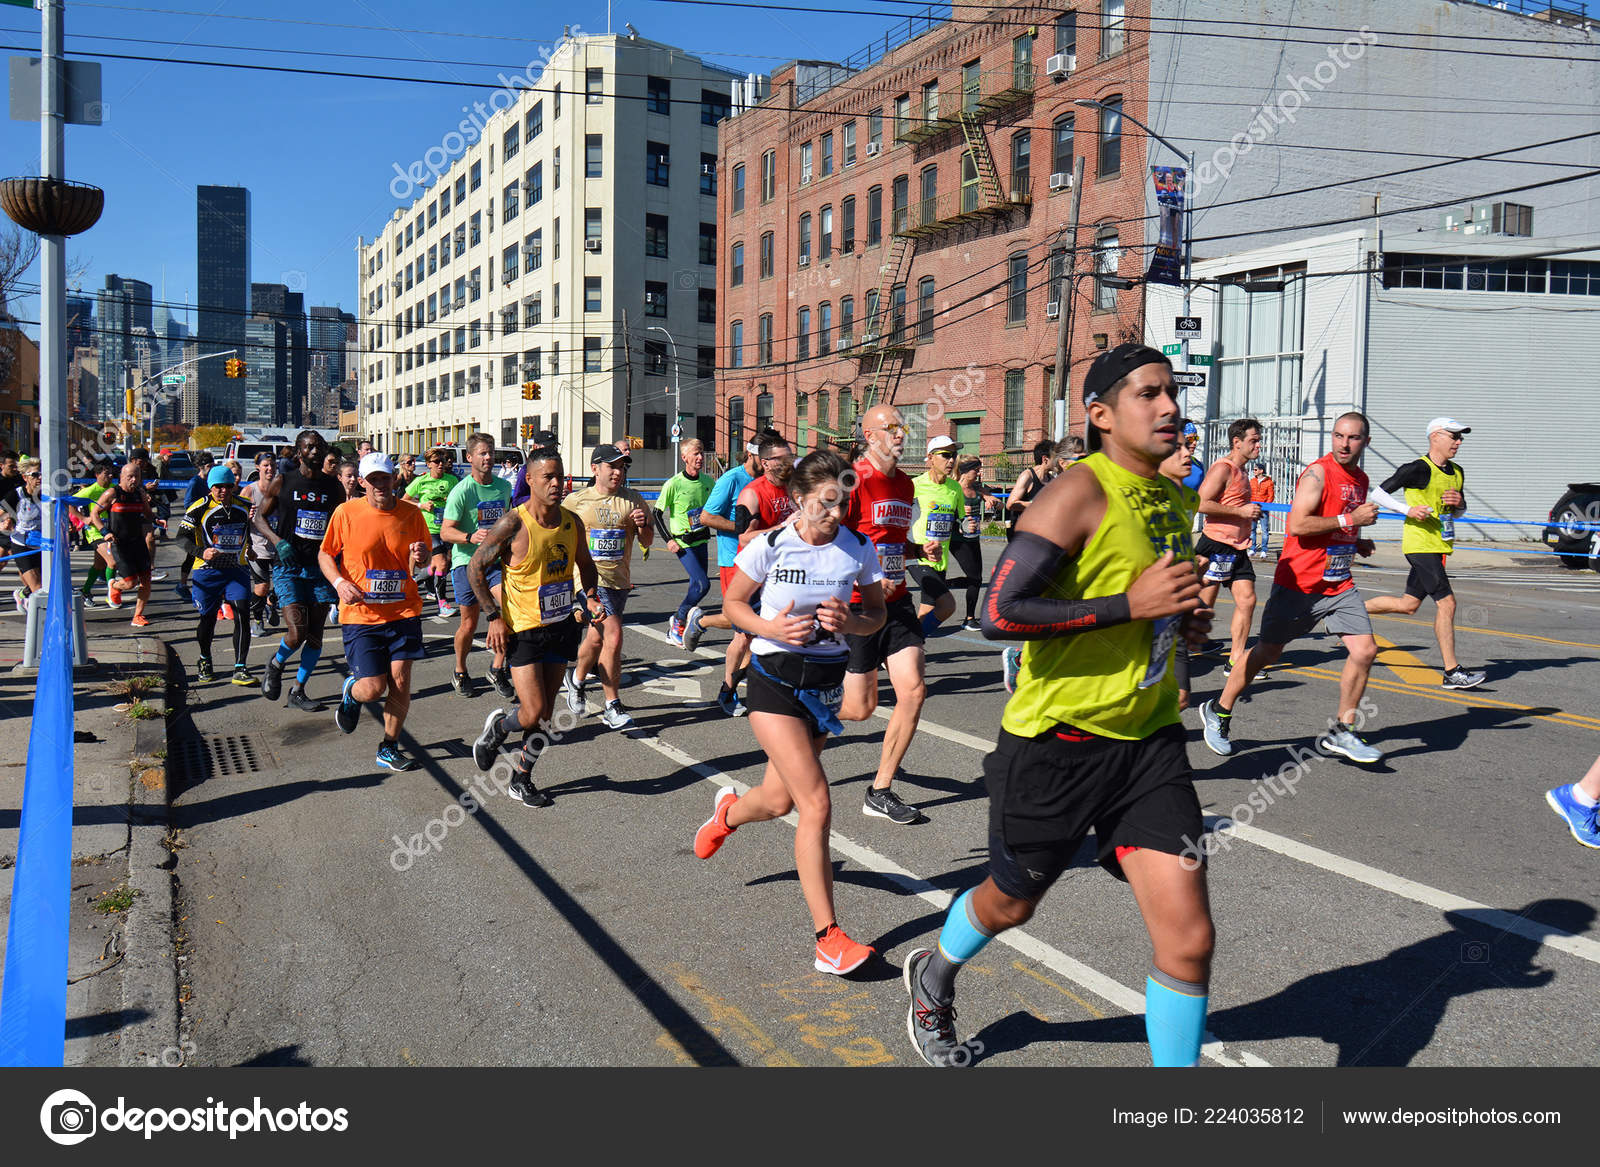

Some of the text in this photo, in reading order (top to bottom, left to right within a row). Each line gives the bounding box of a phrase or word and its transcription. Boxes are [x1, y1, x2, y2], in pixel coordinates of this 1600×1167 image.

[1194, 355, 1202, 364] 10
[877, 504, 913, 520] HAMME
[597, 539, 618, 550] 6259
[774, 564, 806, 585] jam
[826, 577, 836, 585] for
[838, 579, 849, 587] you
[373, 580, 399, 592] 14367
[550, 593, 566, 609] 4817
